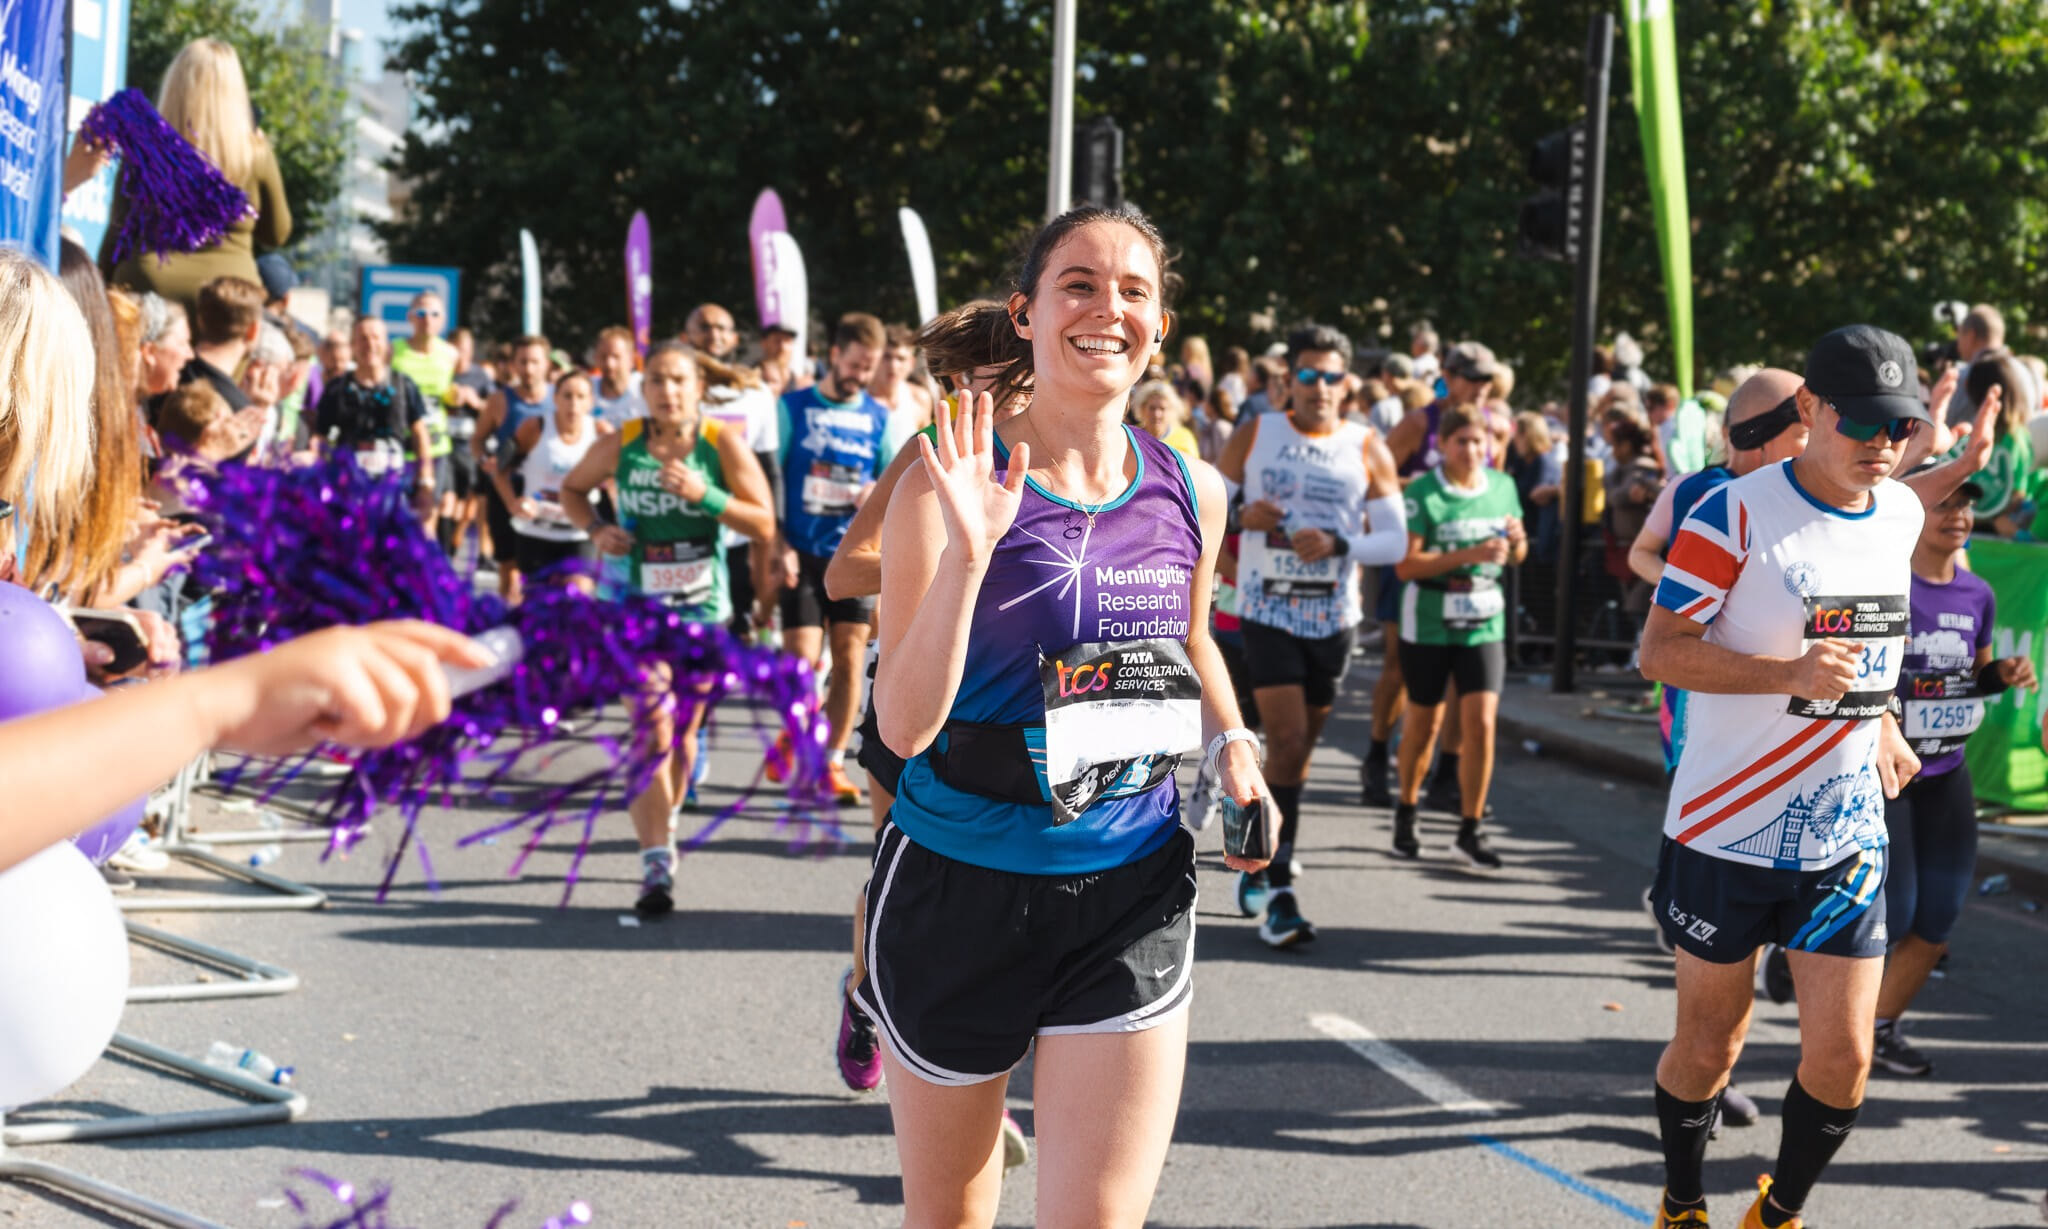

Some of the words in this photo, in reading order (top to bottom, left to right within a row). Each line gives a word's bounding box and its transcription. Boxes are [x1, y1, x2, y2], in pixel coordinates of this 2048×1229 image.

[620, 489, 703, 517] NSPC
[1095, 563, 1186, 588] Meningitis
[1097, 589, 1182, 612] Research
[1856, 603, 1880, 612] TATA
[1098, 615, 1187, 638] Foundation
[1814, 604, 1853, 633] tcs
[1854, 622, 1889, 633] SERVICES
[1855, 612, 1905, 623] CONSULTANCY
[1121, 652, 1154, 664] TATA
[1056, 659, 1113, 698] tcs
[1118, 664, 1192, 678] CONSULTANCY
[1114, 679, 1166, 691] SERVICES
[1920, 704, 1975, 729] 12597
[1102, 760, 1121, 786] new
